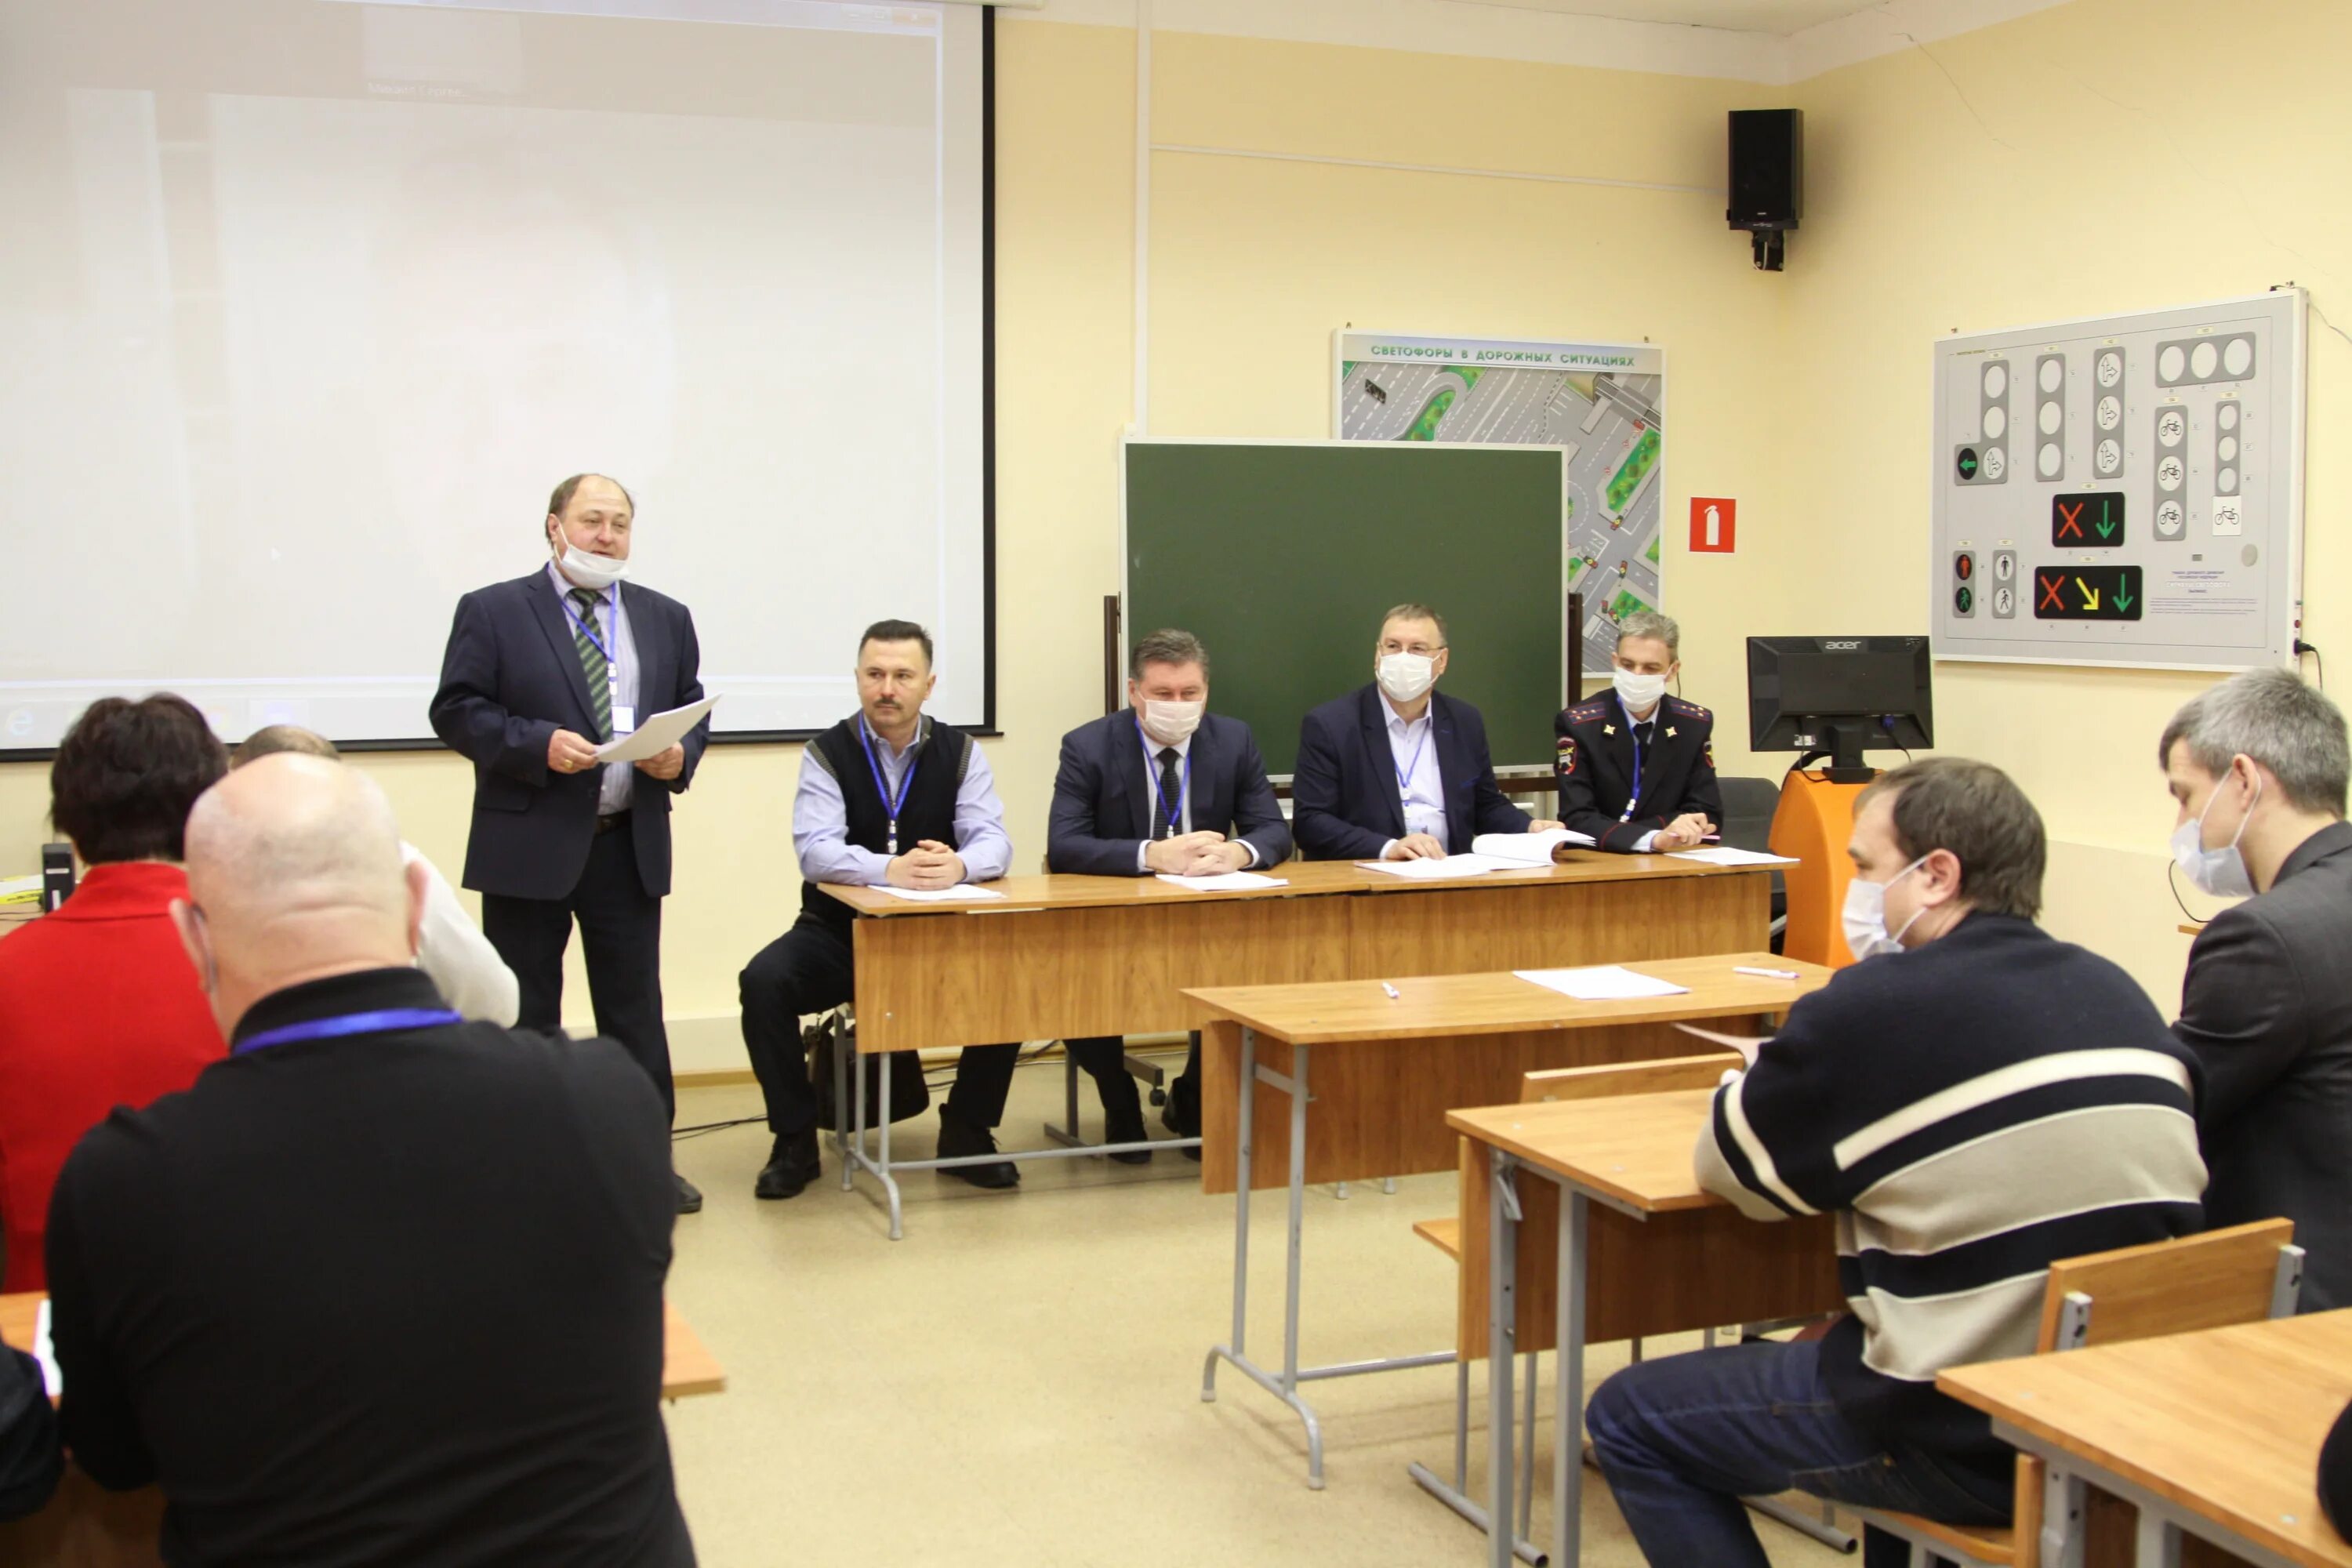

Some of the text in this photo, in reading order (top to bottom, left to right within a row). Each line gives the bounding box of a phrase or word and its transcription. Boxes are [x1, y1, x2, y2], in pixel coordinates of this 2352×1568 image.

[1371, 345, 1635, 367] СВЕТОФОРЫ В ДОРОЖНЫХ СИТУАЦИЯХ
[1825, 641, 1861, 650] acer
